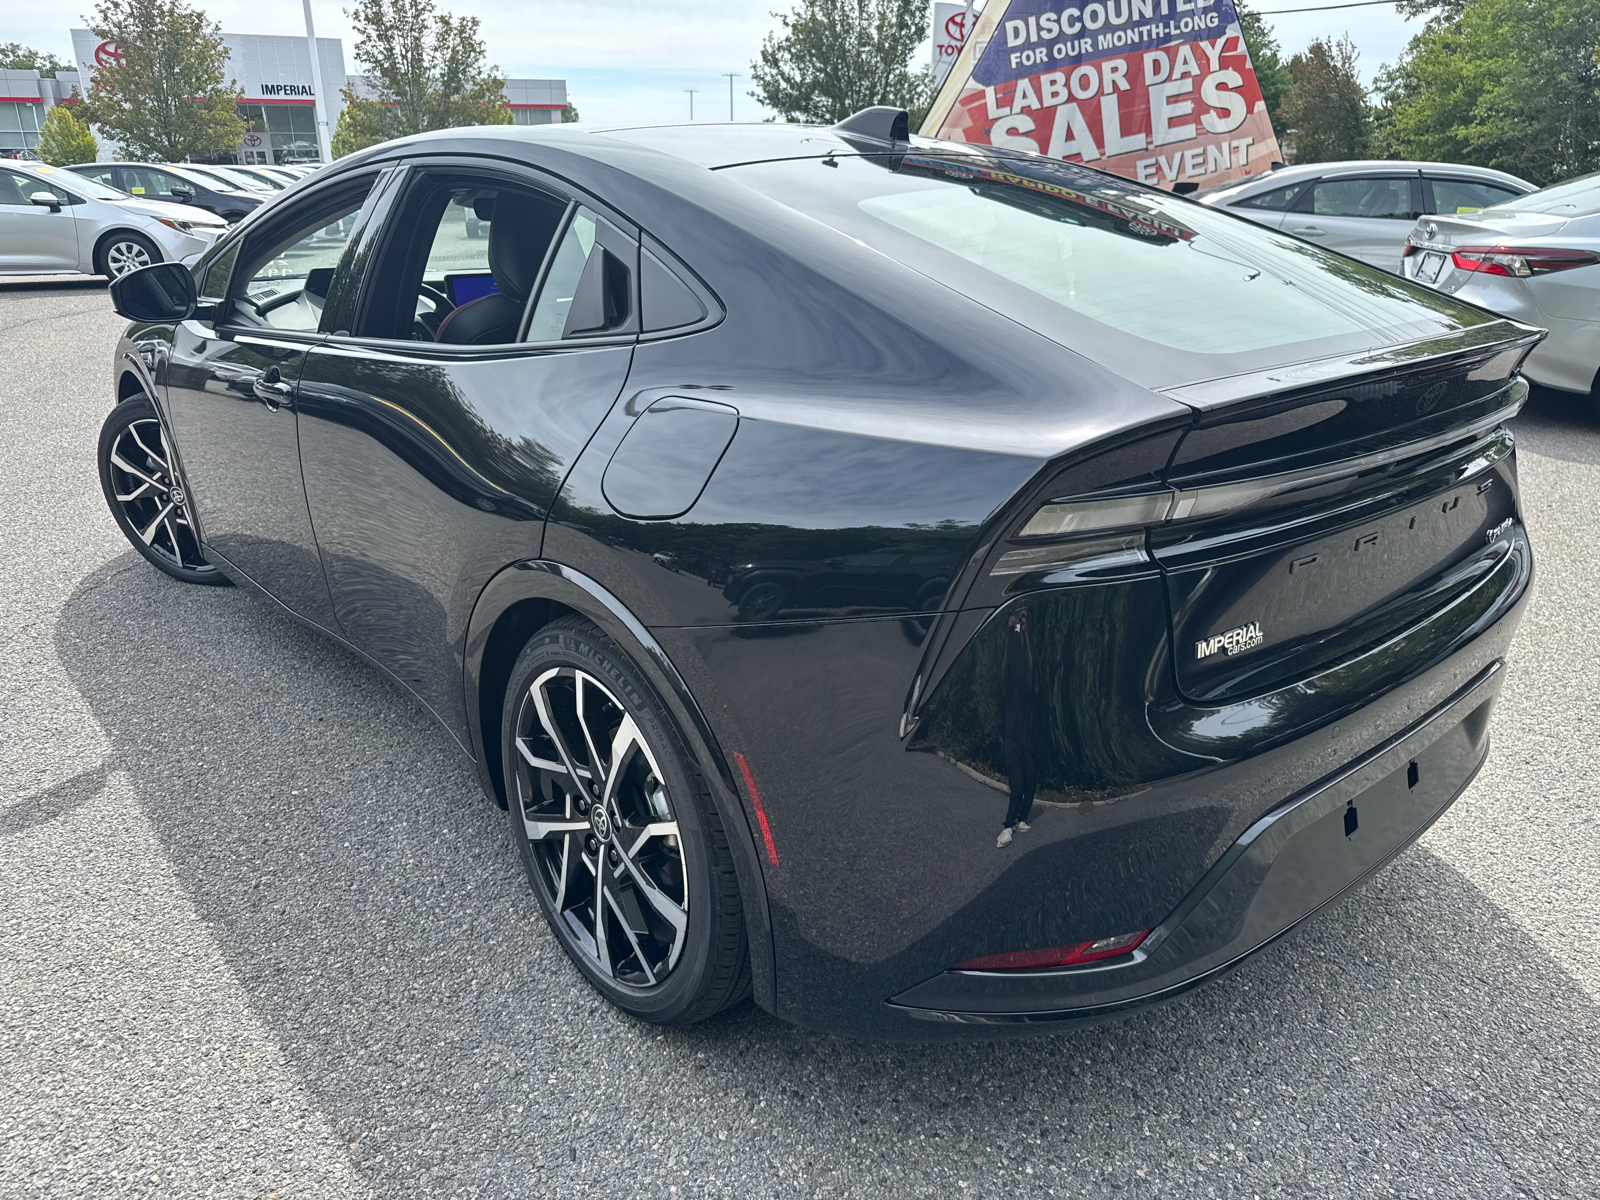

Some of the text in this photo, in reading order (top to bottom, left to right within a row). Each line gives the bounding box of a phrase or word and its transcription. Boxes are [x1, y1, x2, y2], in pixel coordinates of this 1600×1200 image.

[1010, 11, 1219, 69] FOR OUR MONTH-LONG
[261, 84, 315, 96] IMPERIAL
[984, 39, 1227, 120] LABOR DAY
[990, 70, 1247, 162] SALES
[1136, 137, 1253, 185] EVENT
[1196, 621, 1263, 659] IMPERIAL
[1227, 635, 1263, 656] cars.com
[578, 643, 642, 706] MICHELIN
[647, 718, 675, 764] PRIMACY
